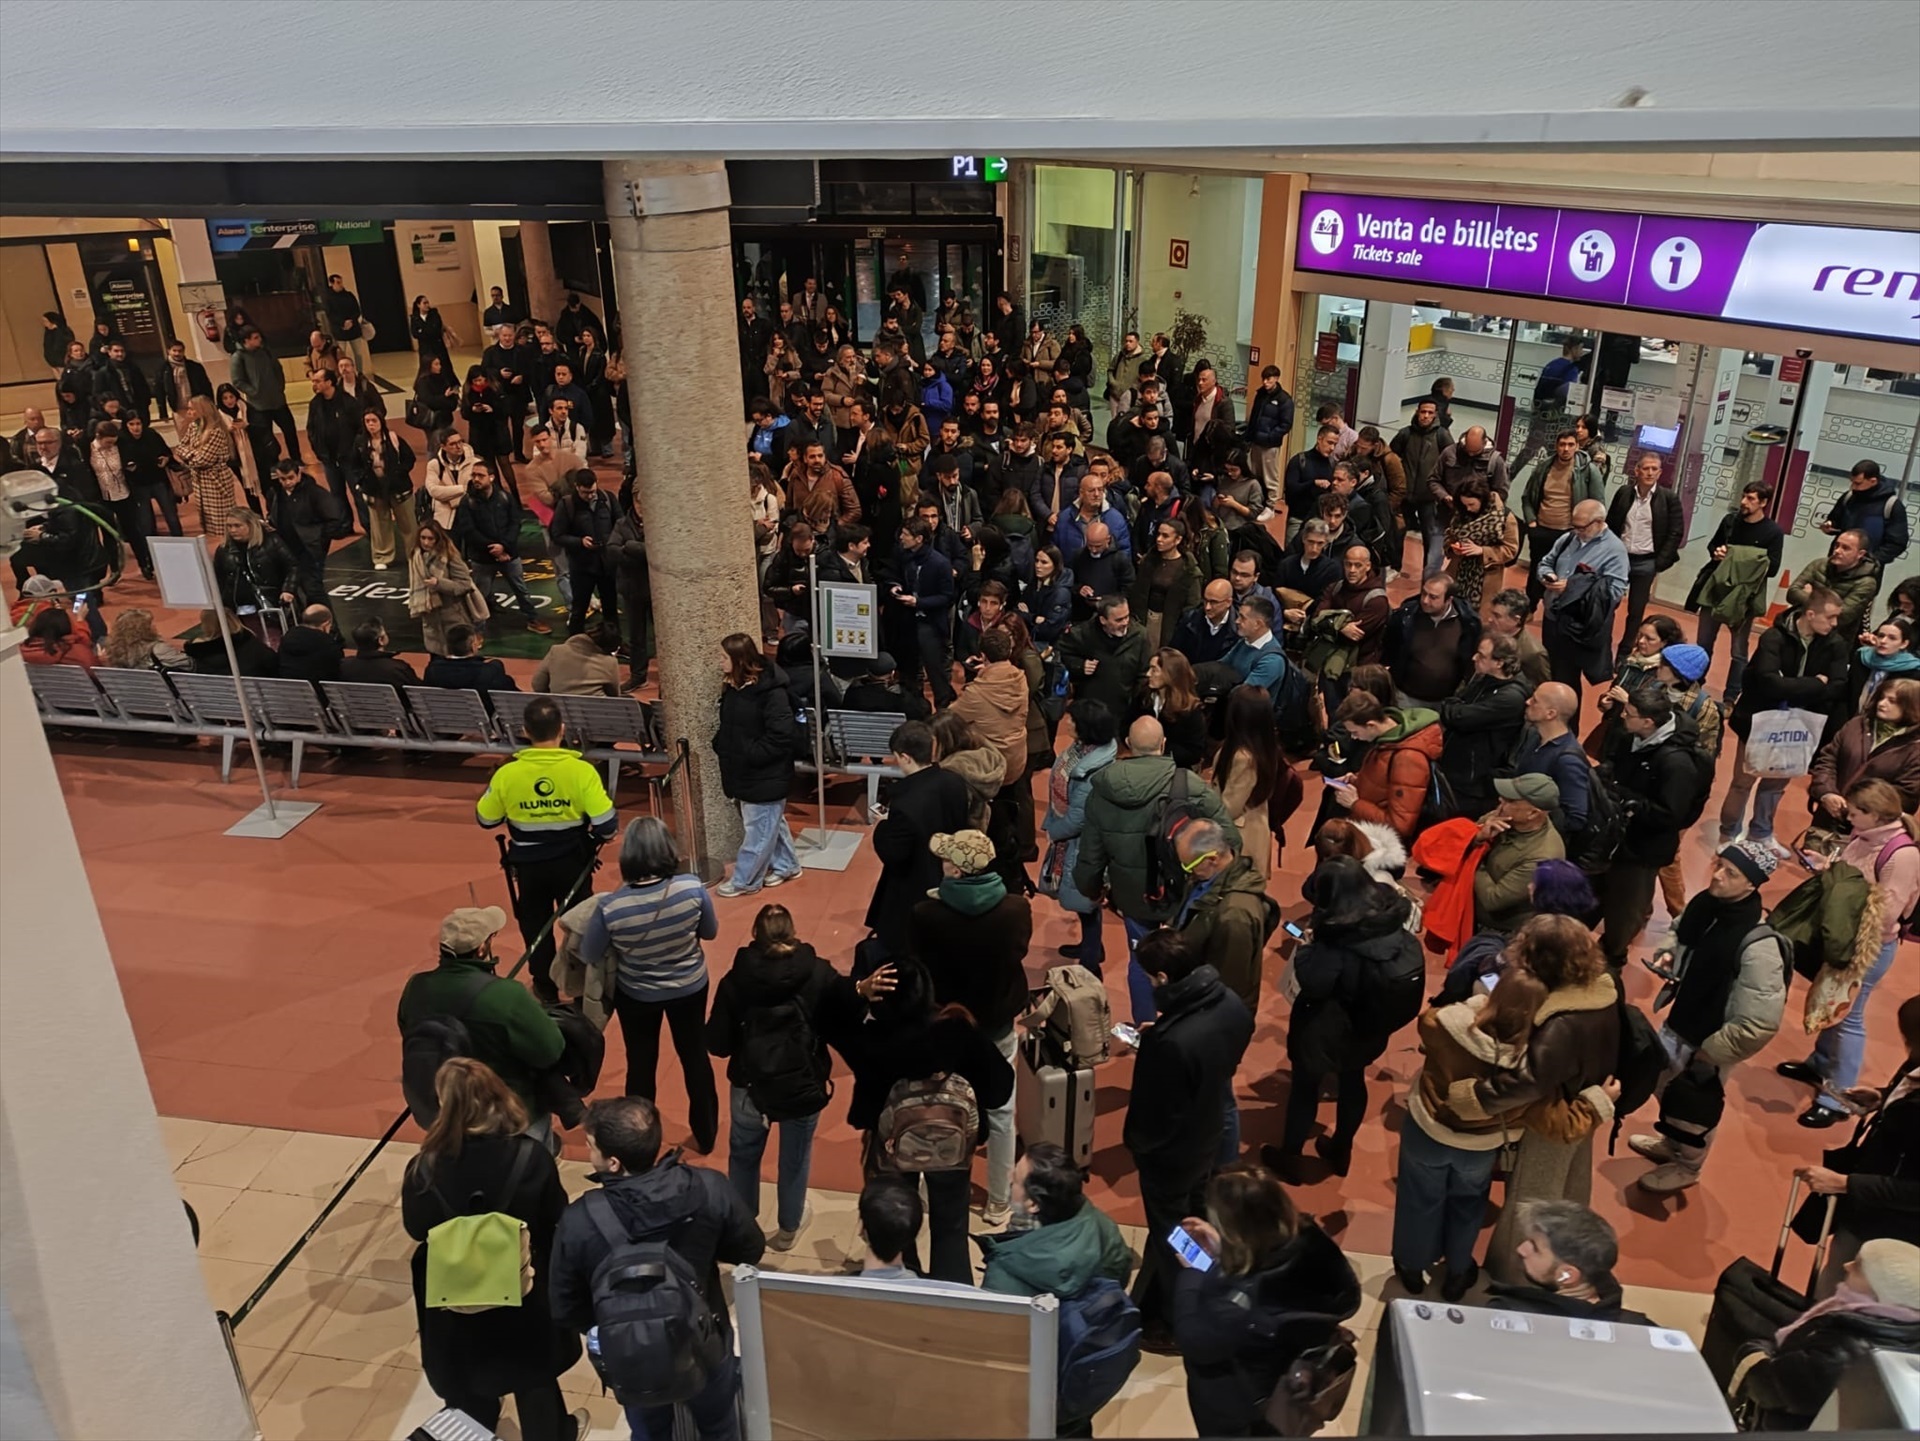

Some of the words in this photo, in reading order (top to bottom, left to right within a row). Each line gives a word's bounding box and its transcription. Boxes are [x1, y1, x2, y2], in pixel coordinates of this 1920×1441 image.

[953, 156, 977, 176] P1
[254, 223, 316, 234] enterprise
[336, 219, 371, 229] National
[218, 227, 246, 236] Alamo
[1357, 213, 1413, 241] Venta
[1420, 217, 1446, 244] de
[1453, 219, 1538, 252] billetes
[1353, 244, 1392, 263] Tickets
[1396, 248, 1423, 266] sale
[1767, 730, 1809, 743] ACTION
[519, 799, 571, 810] ILUNION
